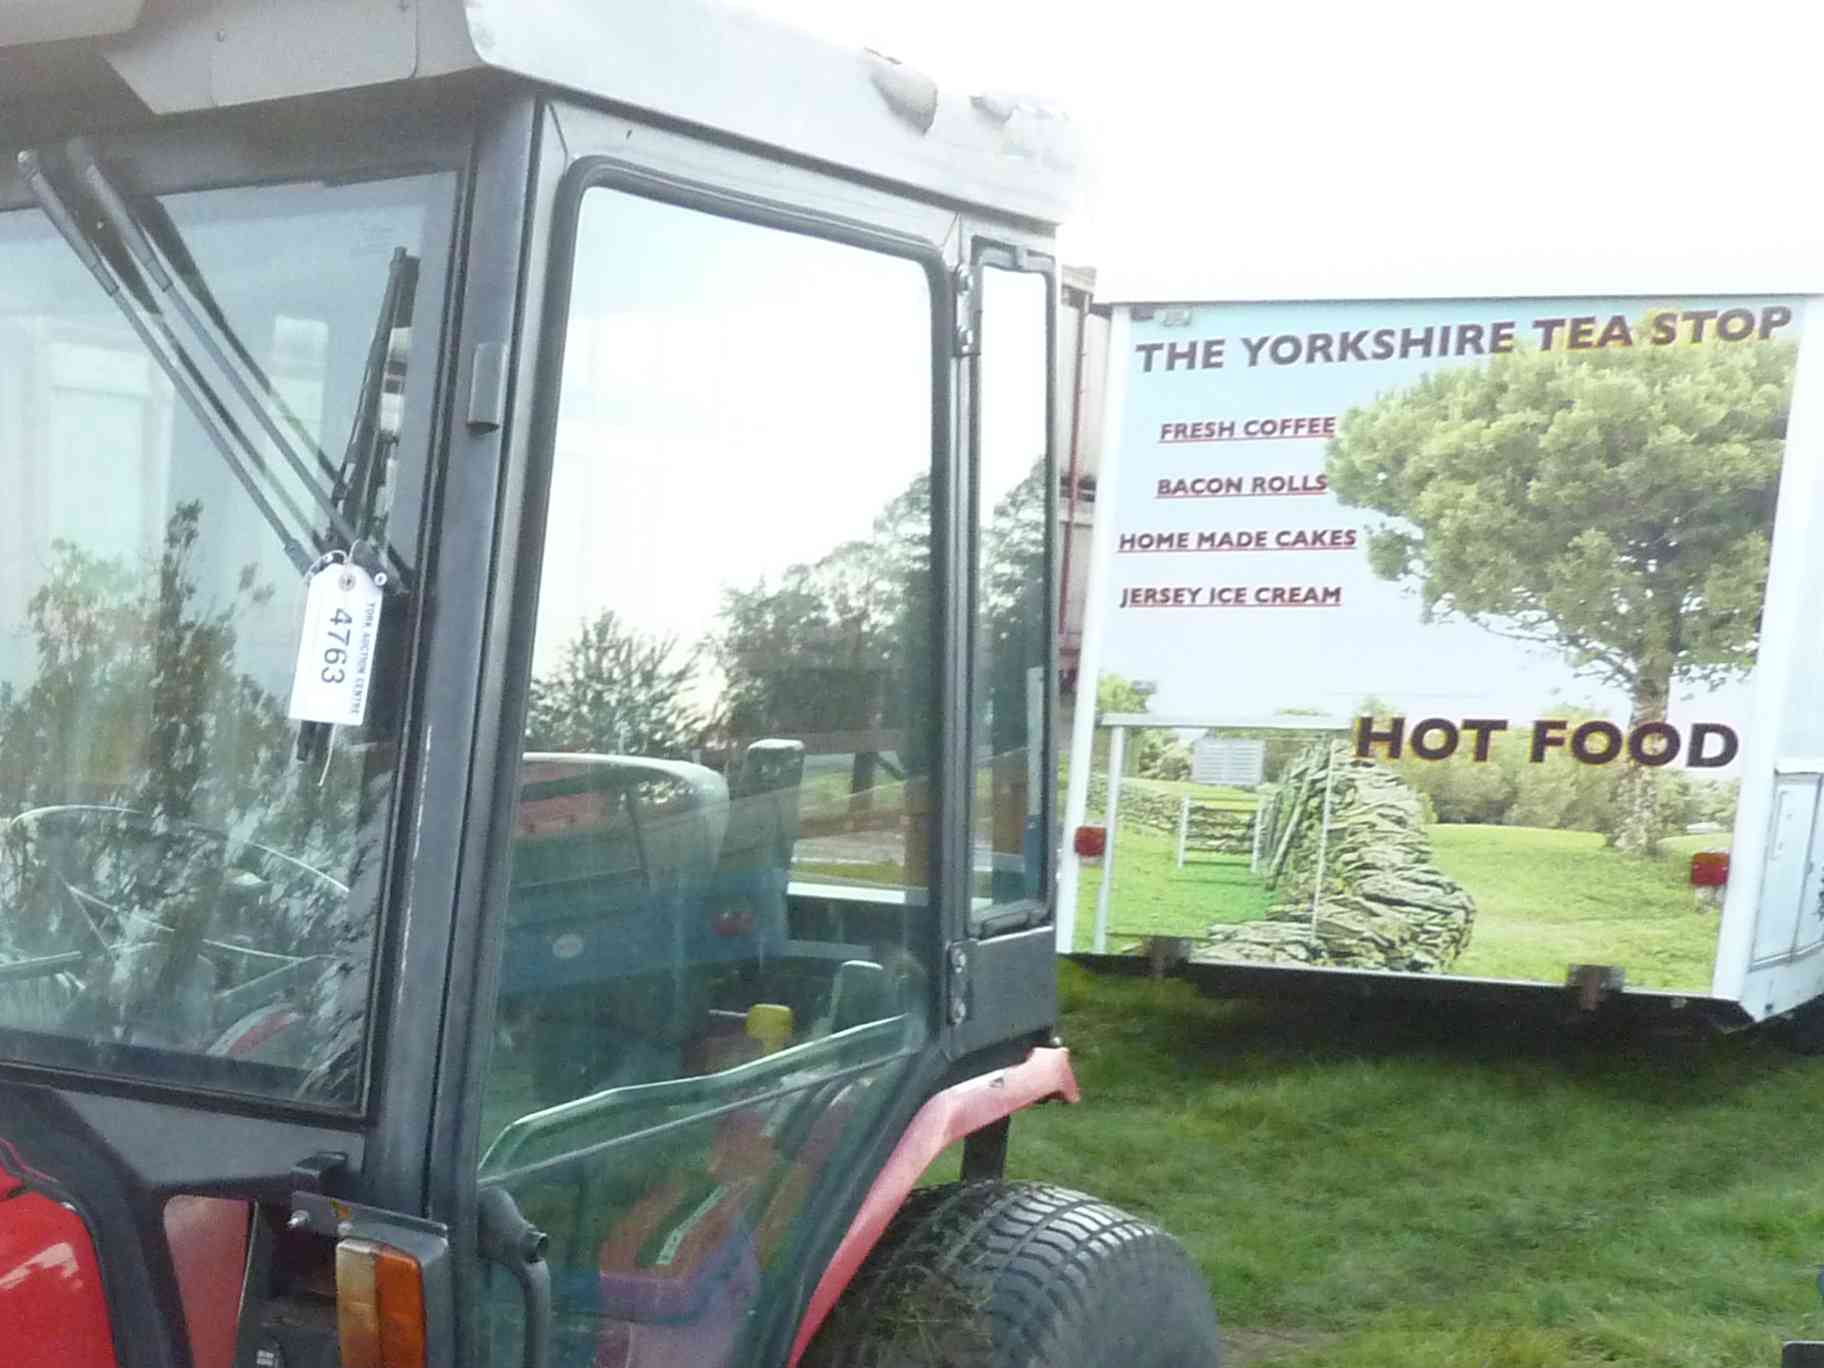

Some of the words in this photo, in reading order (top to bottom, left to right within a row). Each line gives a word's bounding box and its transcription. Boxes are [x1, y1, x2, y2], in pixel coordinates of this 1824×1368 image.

[1135, 338, 1225, 373] THE
[1240, 320, 1516, 368] YORKSHIRE
[1532, 315, 1633, 351] TEA
[1650, 305, 1793, 345] STOP
[1159, 421, 1235, 440] FRESH
[1243, 417, 1336, 436] COFFEE
[1156, 477, 1243, 495] BACON
[1251, 474, 1329, 492] ROLLS
[1119, 532, 1189, 550] HOME
[1196, 530, 1268, 548] MADE
[1275, 529, 1357, 547] CAKES
[1119, 587, 1202, 608] JERSEY
[1209, 587, 1248, 604] ICE
[1253, 586, 1342, 604] CREAM
[320, 607, 353, 684] 4763
[1355, 715, 1509, 763] HOT
[1528, 719, 1739, 768] FOOD
